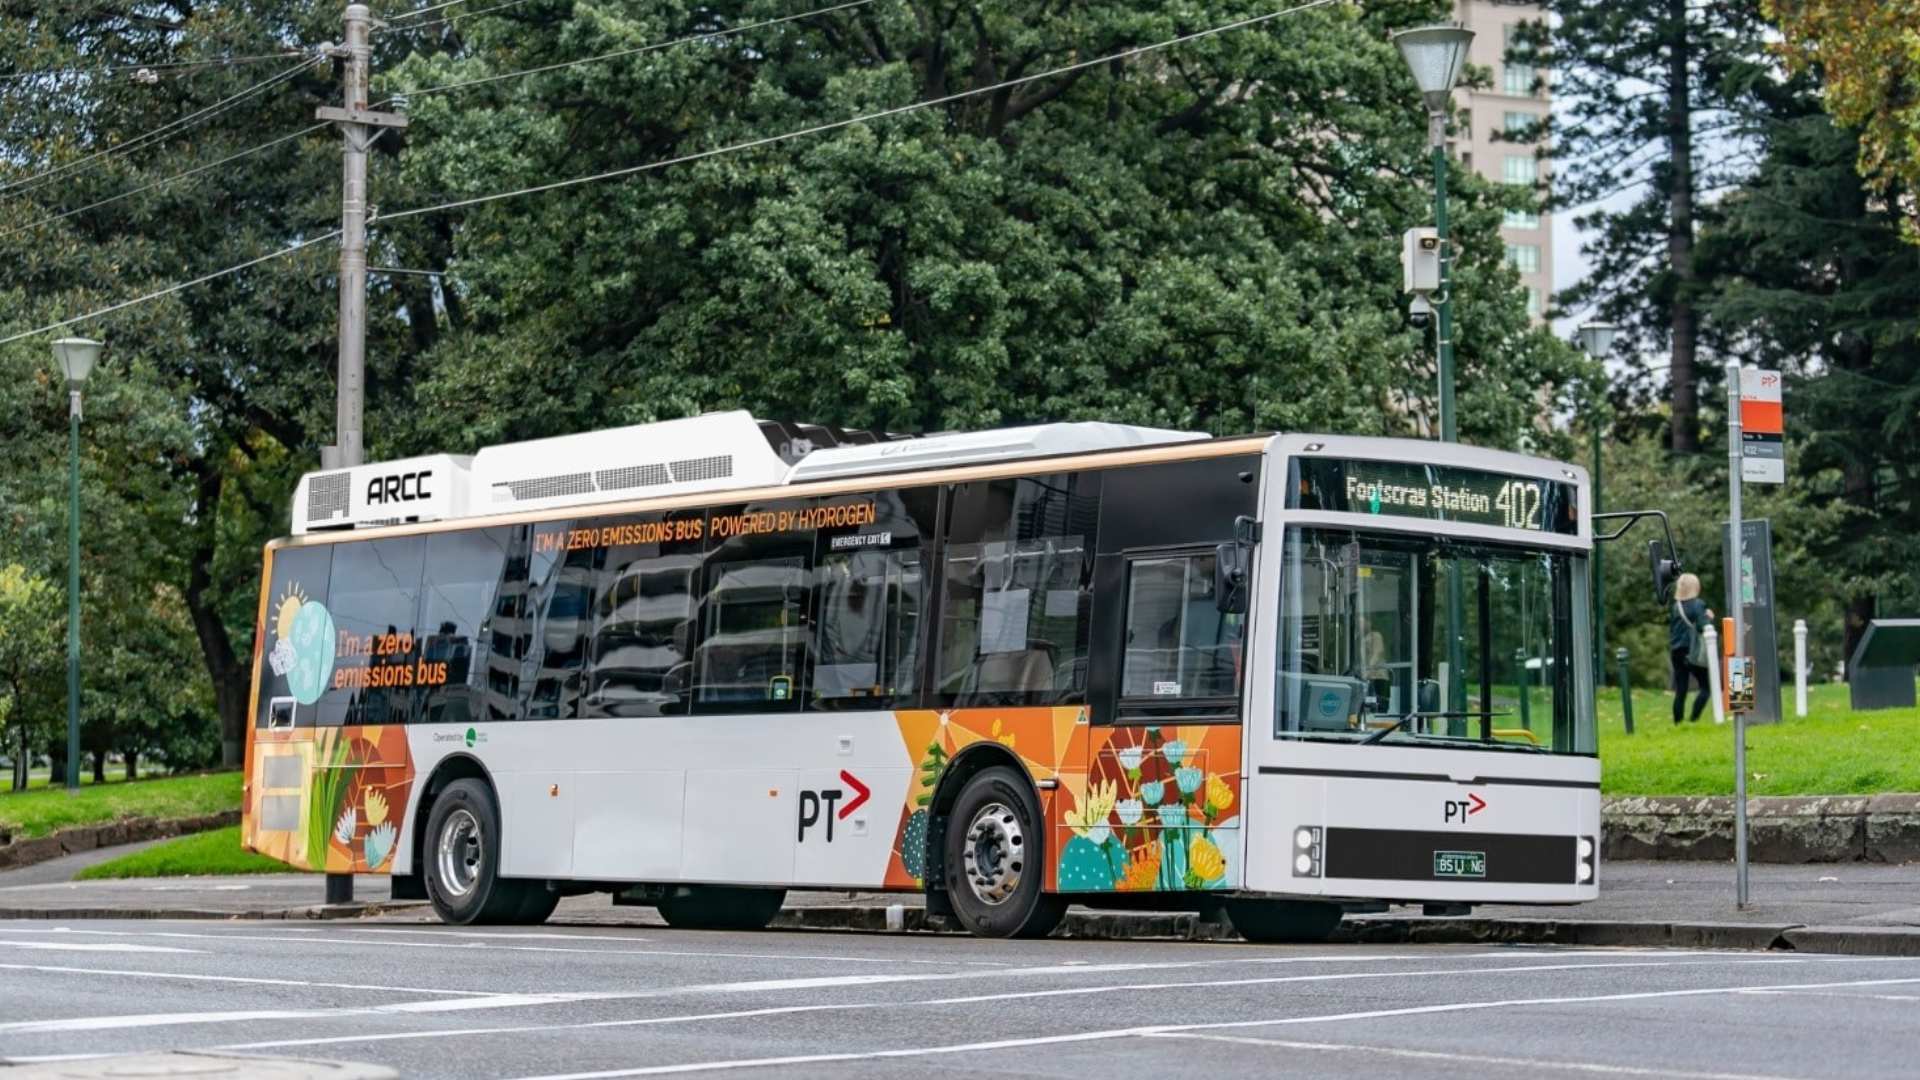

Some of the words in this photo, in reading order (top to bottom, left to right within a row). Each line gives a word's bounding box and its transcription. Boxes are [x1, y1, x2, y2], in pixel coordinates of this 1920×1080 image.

[1744, 445, 1758, 455] 402
[367, 470, 432, 505] ARCC
[710, 511, 776, 538] POWERED
[778, 510, 797, 532] BY
[799, 503, 877, 529] HYDROGEN
[1431, 485, 1490, 513] Station
[1495, 481, 1541, 530] 402
[534, 532, 555, 553] I'M
[555, 533, 564, 551] A
[567, 528, 599, 550] ZERO
[601, 521, 674, 547] EMISSIONS
[675, 517, 703, 541] BUS
[831, 534, 867, 548] EMERGENCY
[867, 533, 880, 545] EXIT
[336, 629, 360, 658] I'm
[363, 635, 373, 656] a
[376, 631, 412, 656] zero
[334, 658, 414, 690] emissions
[416, 656, 448, 686] bus
